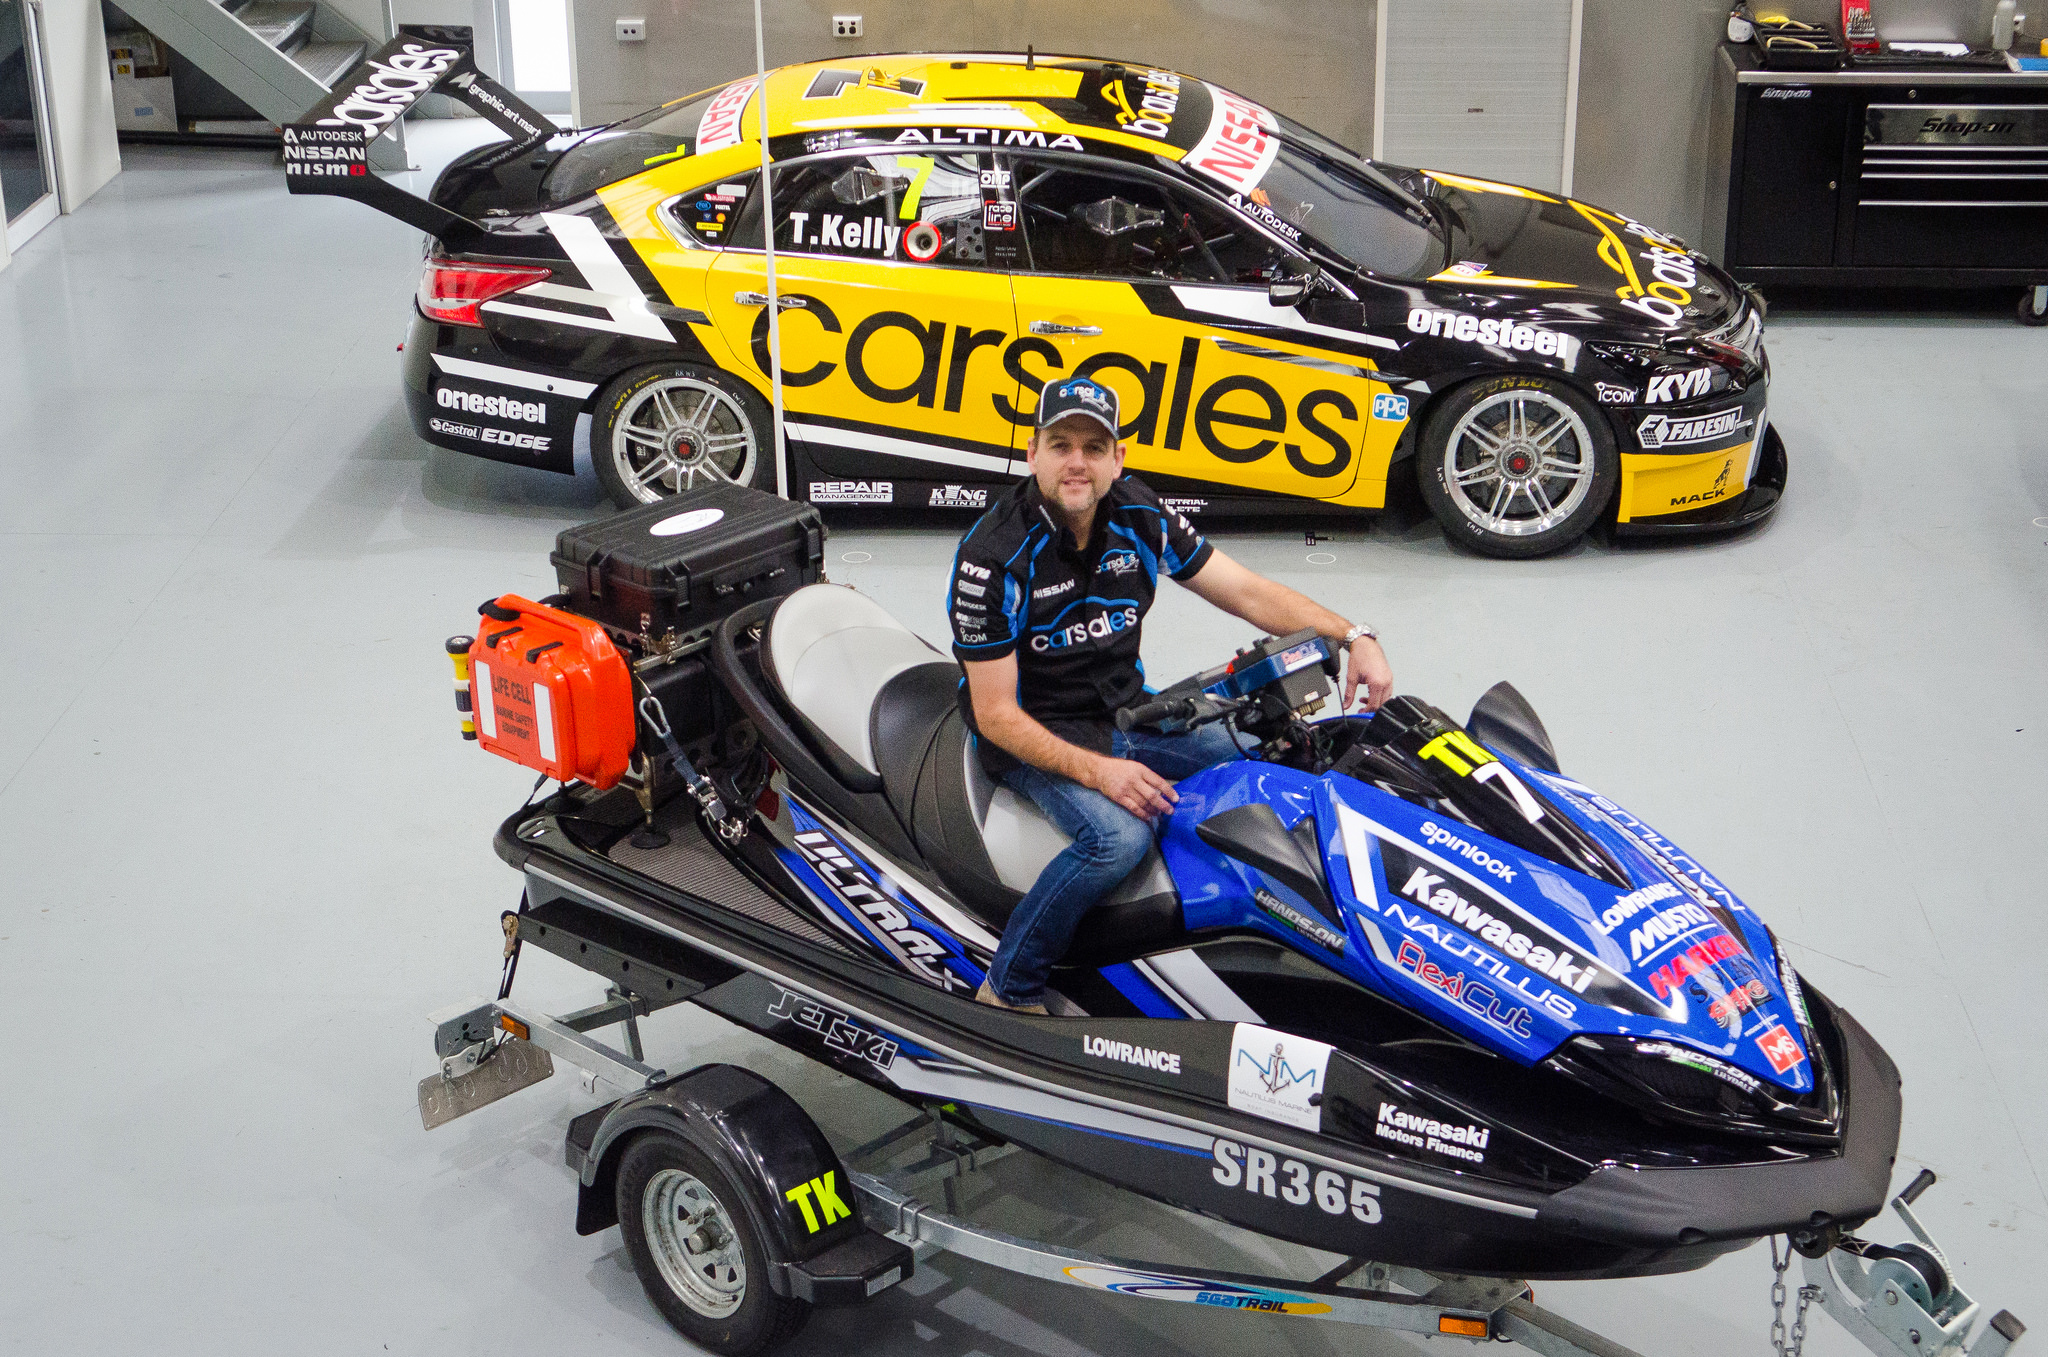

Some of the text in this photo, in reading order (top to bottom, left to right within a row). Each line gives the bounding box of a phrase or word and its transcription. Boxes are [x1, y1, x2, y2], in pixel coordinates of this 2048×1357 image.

[468, 84, 541, 137] graphic art mart
[1919, 117, 2014, 136] Snap-on
[284, 146, 366, 160] NISSAN
[300, 131, 363, 141] AUTODESK
[894, 128, 1084, 151] ALTIMA
[286, 163, 366, 176] nismo
[897, 156, 935, 220] 7
[790, 211, 901, 257] T.Kelly
[1243, 202, 1302, 242] AUTODESK
[1407, 308, 1569, 359] onesteel
[437, 388, 546, 424] onesteel
[751, 293, 1359, 478] carsales
[1645, 368, 1712, 404] KYB
[1375, 396, 1407, 418] PPG
[1668, 412, 1737, 442] FARESIN
[441, 421, 552, 451] Castrol EDGE
[809, 481, 893, 493] REPAIR
[1670, 488, 1726, 506] MACK
[1033, 578, 1075, 599] NISSAN
[1031, 607, 1138, 652] carsales
[492, 673, 532, 705] LIFE CELL
[1417, 730, 1500, 778] TK
[1420, 820, 1518, 884] spinlock
[1255, 890, 1344, 948] HANDS-ON
[1401, 865, 1598, 994] Kawasaki
[1591, 882, 1684, 936] LOWRANCE
[1632, 902, 1709, 961] MUSTO
[1383, 903, 1577, 1020] NAUTILUS
[1397, 939, 1534, 1039] FlexiCut
[1083, 1034, 1181, 1075] LOWRANCE
[1234, 1087, 1313, 1115] NAUTILUS MARINE
[1375, 1122, 1484, 1163] Motors Finance
[1378, 1101, 1491, 1149] Kawasaki
[1212, 1138, 1383, 1225] SR365
[786, 1170, 852, 1235] TK
